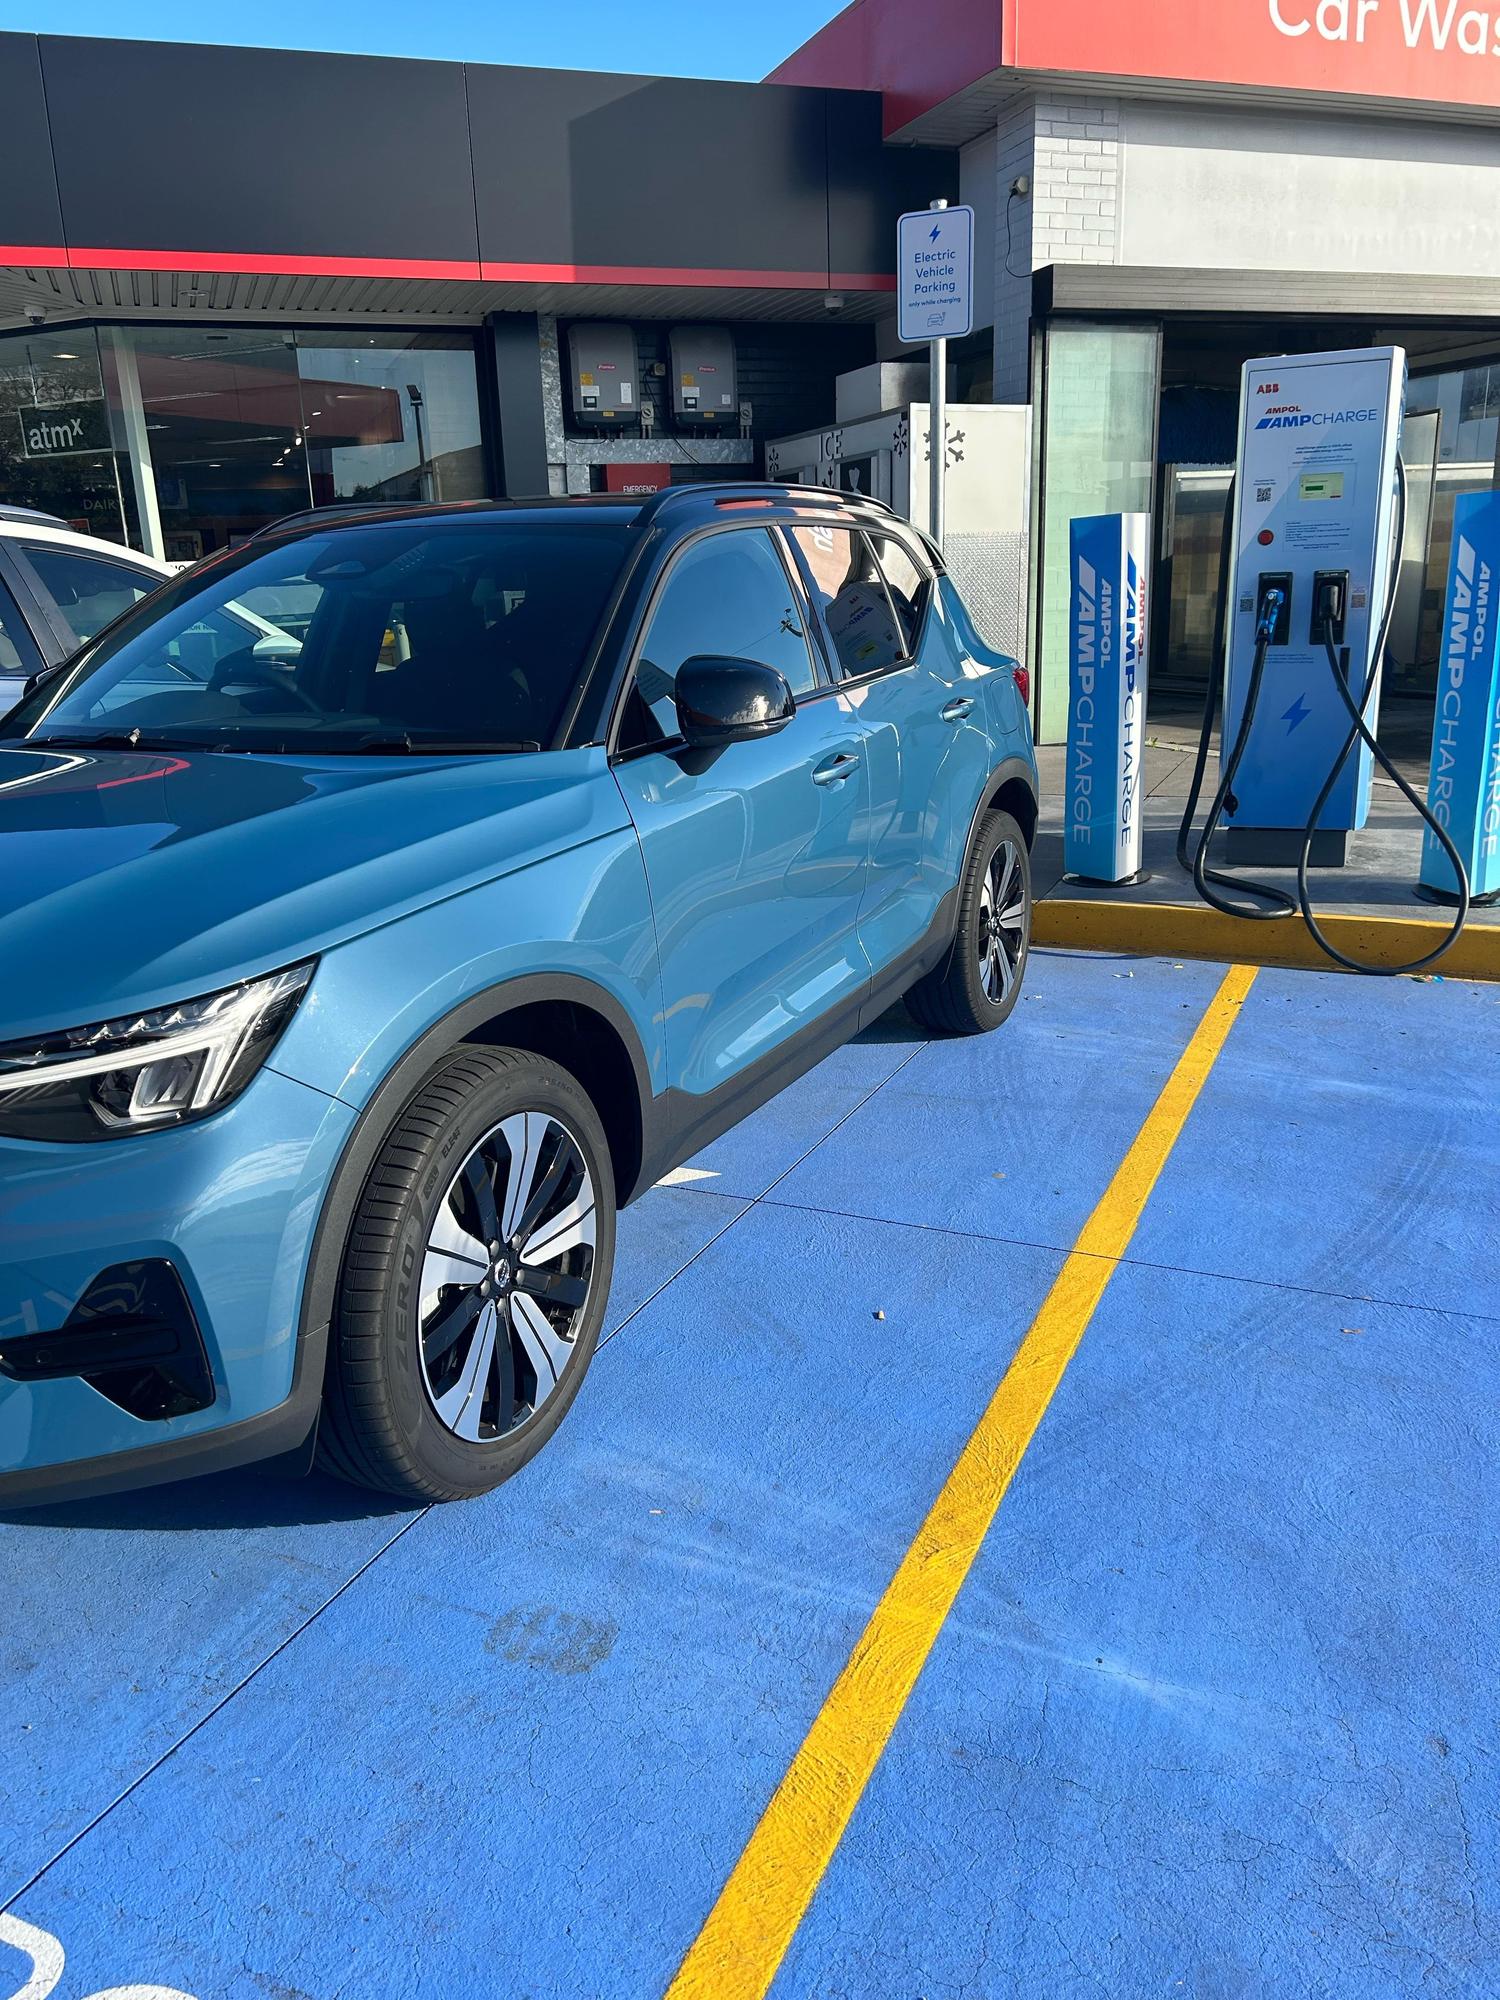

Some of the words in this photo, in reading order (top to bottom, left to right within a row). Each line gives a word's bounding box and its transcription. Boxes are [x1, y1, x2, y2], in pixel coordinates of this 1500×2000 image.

[1269, 0, 1379, 43] Car
[914, 249, 956, 263] Electric
[915, 265, 954, 278] Vehicle
[914, 281, 956, 294] Parking
[1256, 383, 1280, 394] ABB
[1265, 405, 1301, 414] AMPOL
[1269, 408, 1379, 429] AMPCHARGE
[819, 430, 844, 462] ICE
[623, 485, 658, 494] EMERGENCY
[1101, 578, 1112, 669] AMPOL
[1137, 576, 1146, 664] AMPOL
[1471, 561, 1491, 661] AMPOL
[1073, 592, 1096, 845] AMPCHARGE
[1121, 589, 1136, 848] AMPCHARGE
